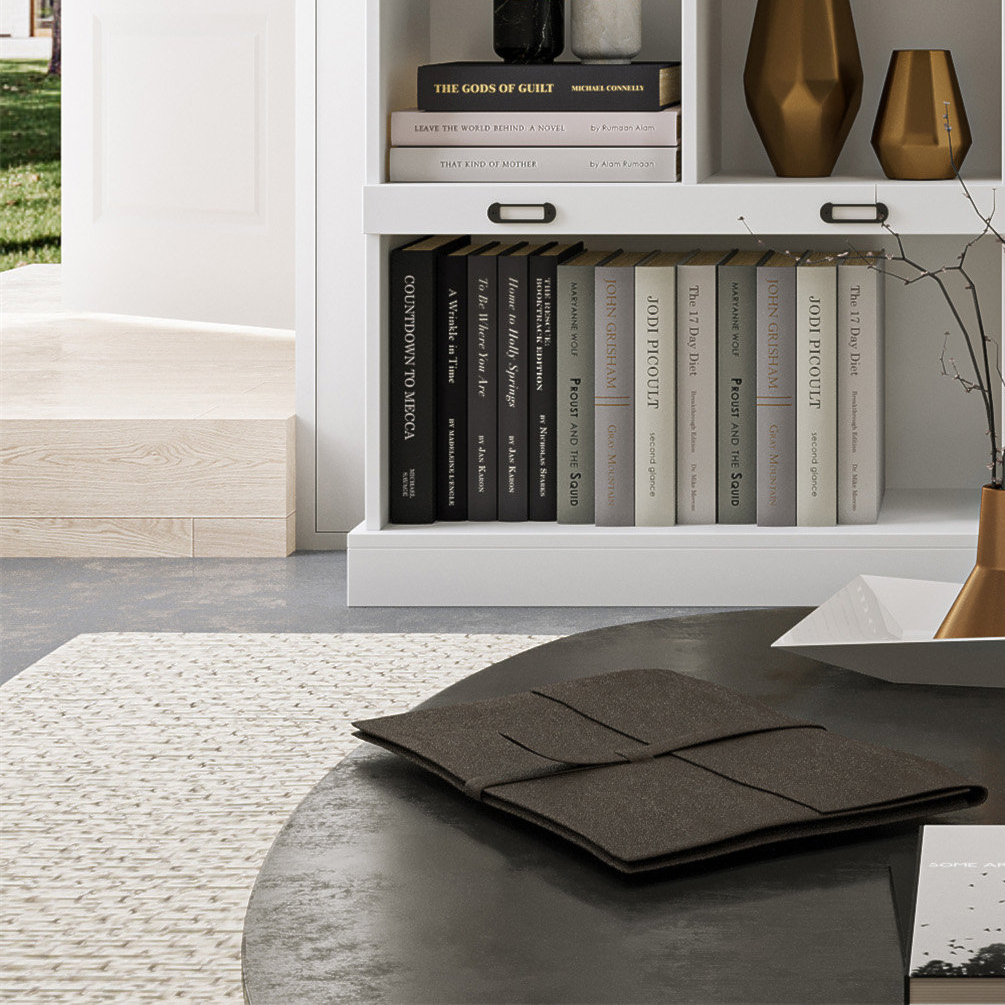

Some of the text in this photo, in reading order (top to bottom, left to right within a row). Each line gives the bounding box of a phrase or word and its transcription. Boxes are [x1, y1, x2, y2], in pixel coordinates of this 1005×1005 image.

[434, 84, 554, 93] THE GODS OF GUILT
[404, 275, 415, 440] COUNTDOWN TO MECCA
[448, 289, 458, 383] A Wrinkle in Time
[478, 278, 488, 397] To Be Where You Are
[506, 277, 519, 407] Home to Holly Springs
[569, 282, 579, 358] MARYANNE WOLF
[603, 277, 616, 390] JOHN GRISHAM
[647, 296, 658, 409] JODI PICOULT
[848, 285, 860, 376] The 17 Day Diet
[569, 378, 582, 506] PROUST AND THE SQUID
